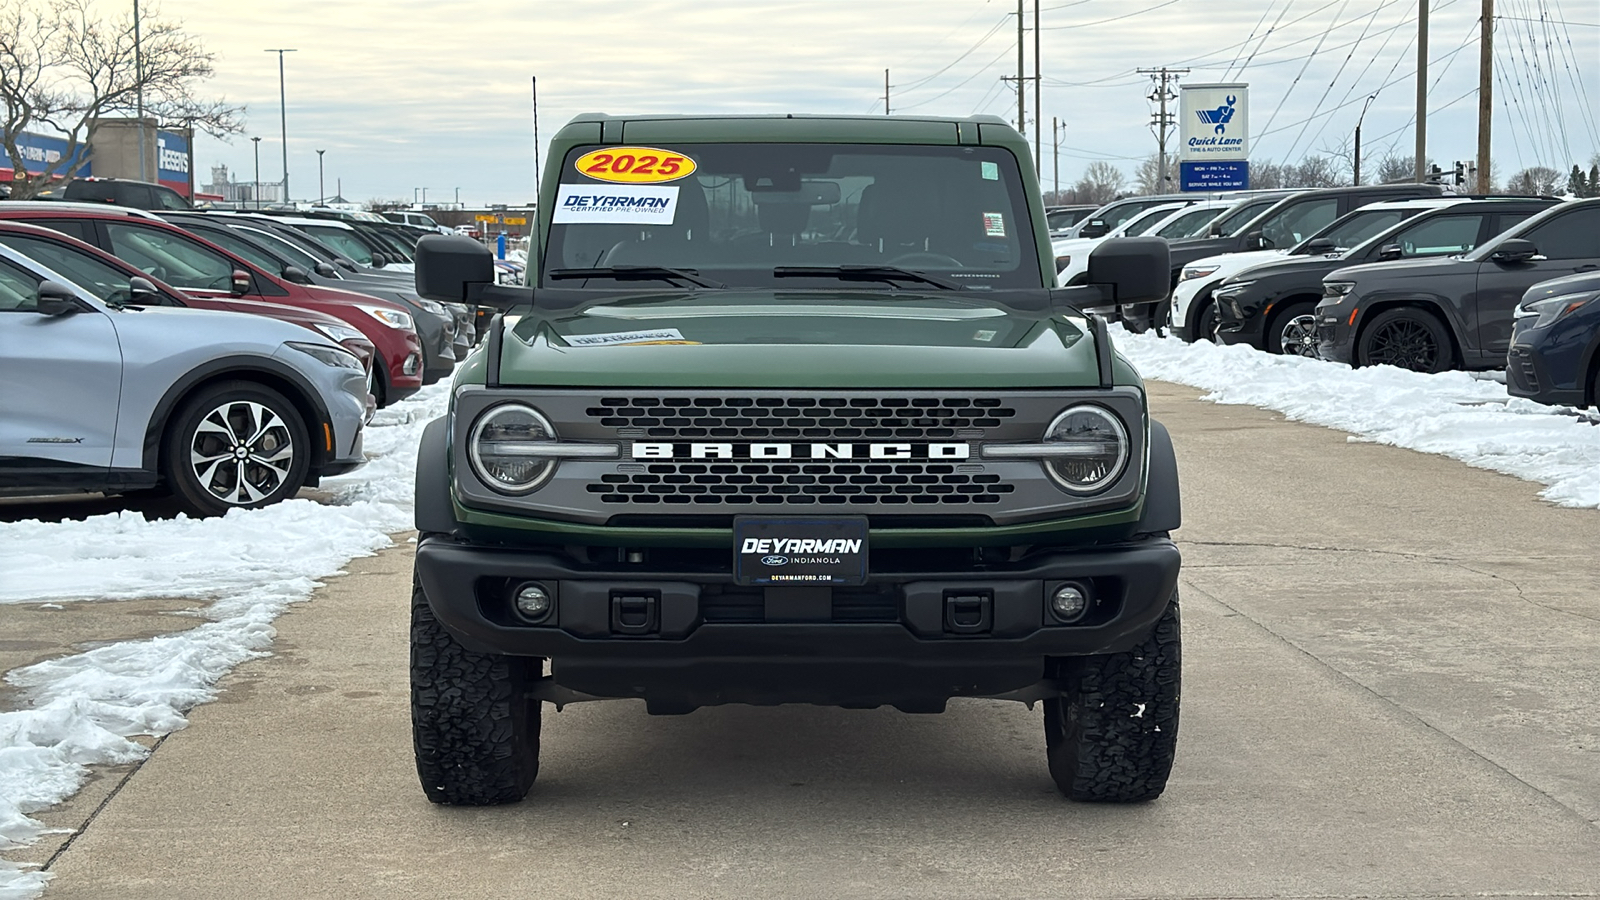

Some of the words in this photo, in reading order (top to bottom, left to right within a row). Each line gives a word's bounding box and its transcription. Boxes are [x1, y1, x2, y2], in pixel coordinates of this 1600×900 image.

[1188, 137, 1217, 146] Quick
[1218, 136, 1243, 145] Lane
[586, 154, 684, 175] 2025
[563, 195, 670, 208] DEYARMAN
[632, 443, 970, 459] BRONCO
[741, 538, 862, 554] DEYARMAN
